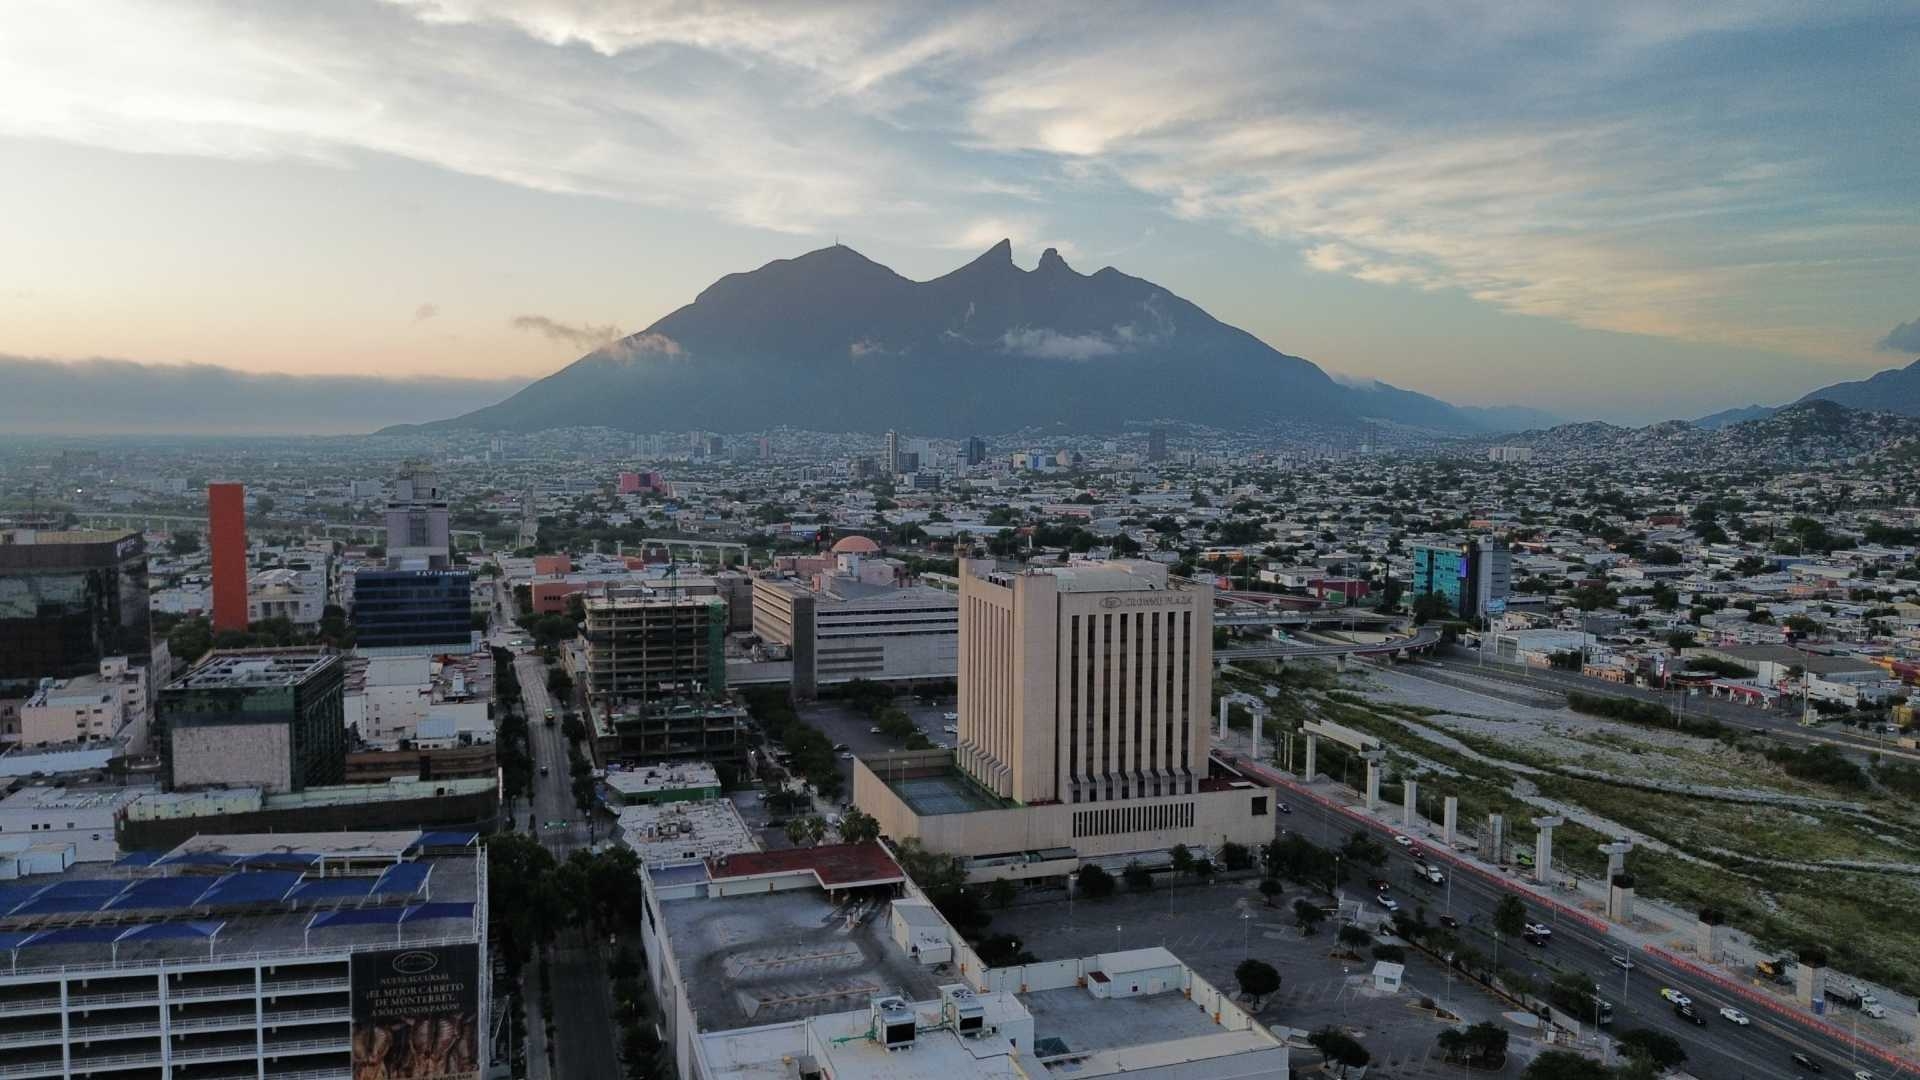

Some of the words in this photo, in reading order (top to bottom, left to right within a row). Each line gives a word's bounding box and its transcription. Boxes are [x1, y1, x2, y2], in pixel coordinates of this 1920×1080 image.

[1165, 596, 1192, 605] PLAZA
[408, 973, 449, 983] SUCURSAL
[383, 986, 417, 997] MEJOR
[418, 982, 464, 994] CABRITO
[375, 998, 389, 1007] DE
[403, 1006, 429, 1014] UNOS
